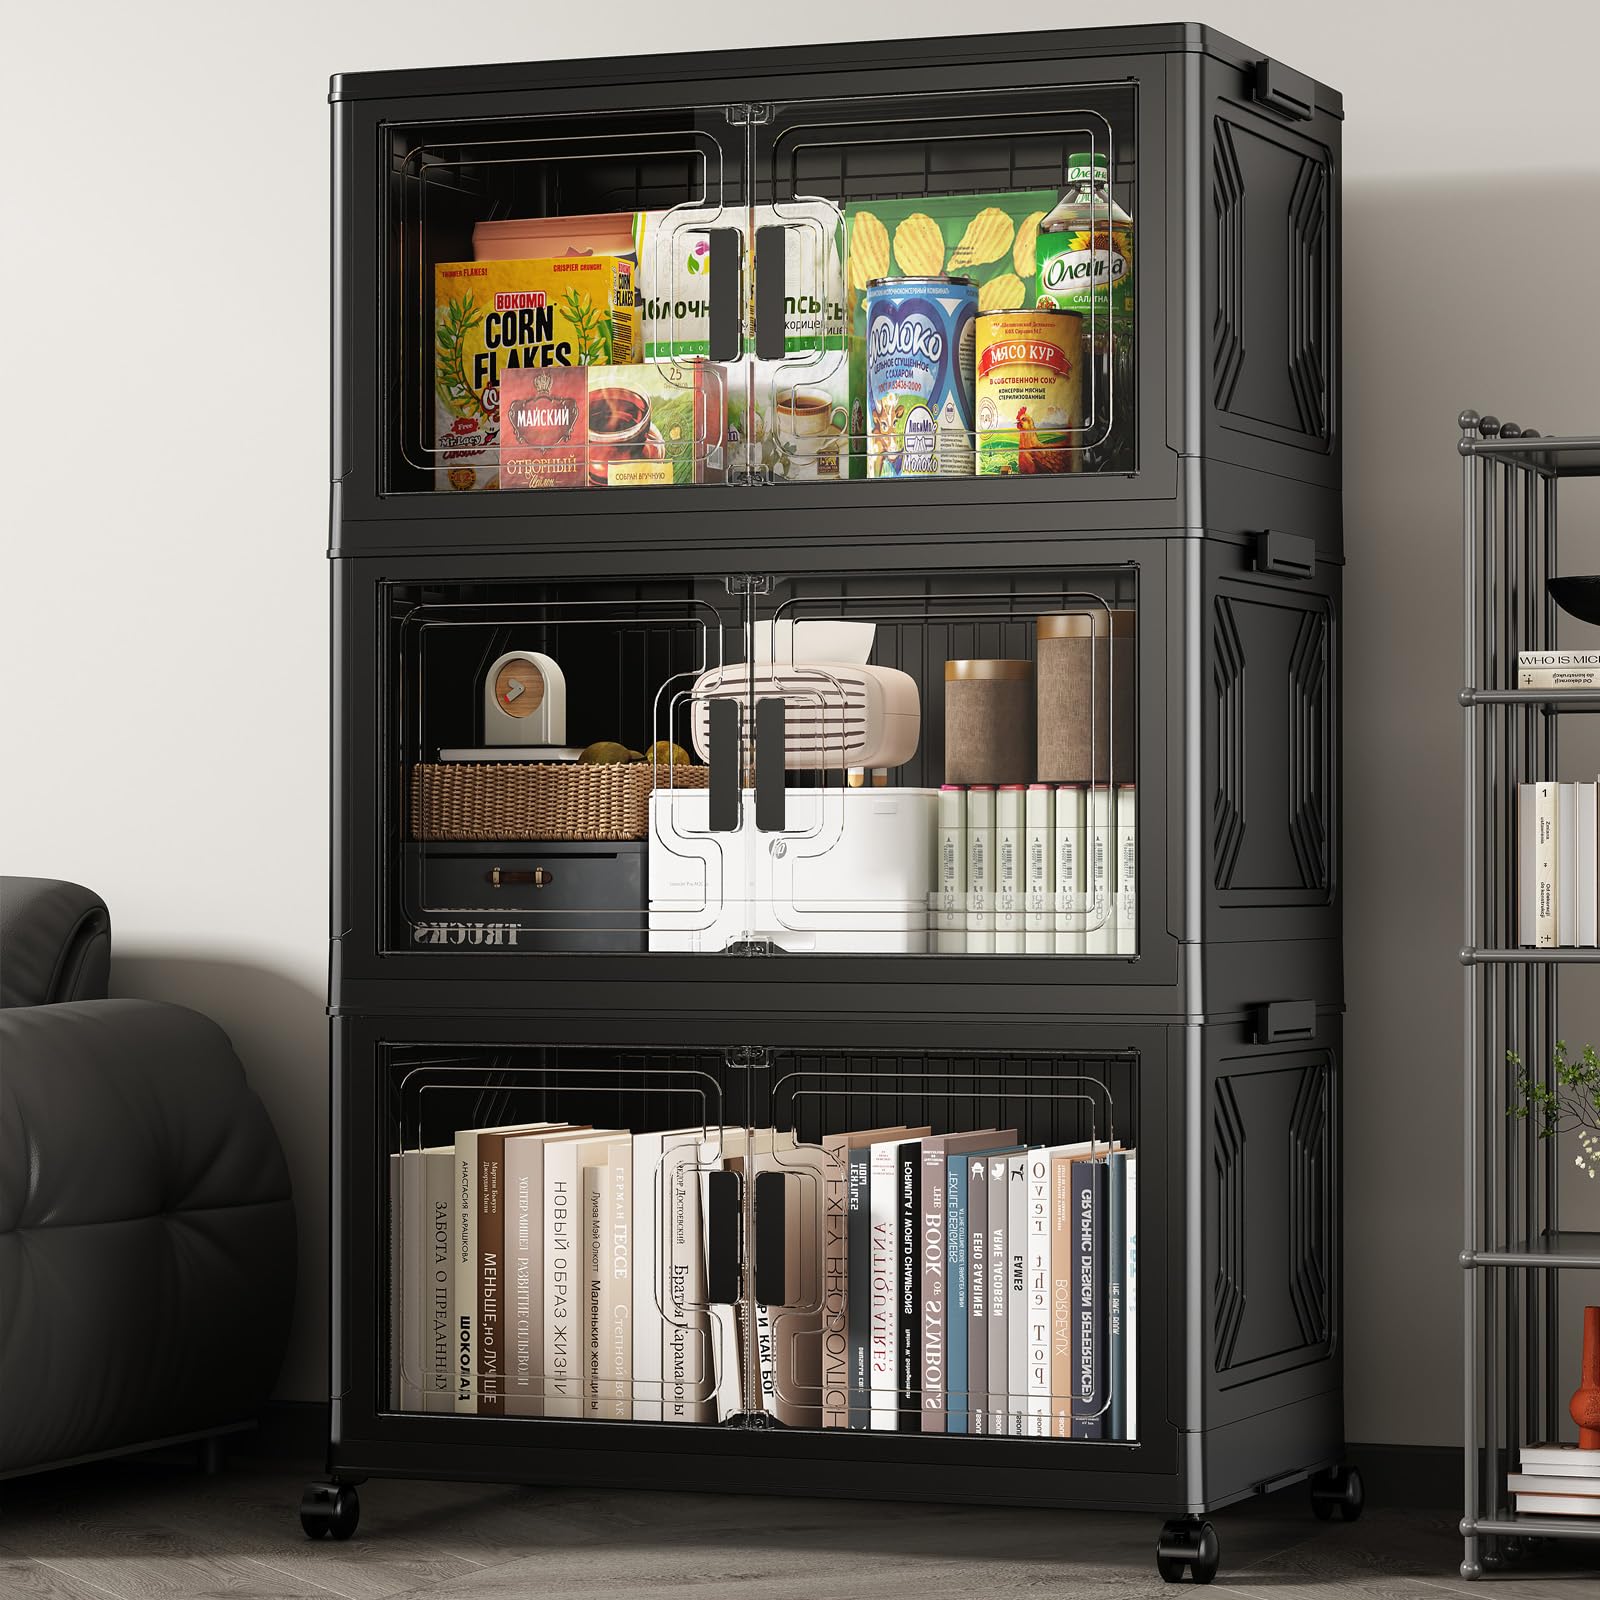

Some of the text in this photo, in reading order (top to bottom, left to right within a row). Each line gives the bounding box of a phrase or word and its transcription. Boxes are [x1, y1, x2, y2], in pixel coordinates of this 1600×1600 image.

[553, 264, 579, 272] CRISPIER
[619, 274, 631, 289] CORN
[496, 292, 545, 310] BOKOMO
[617, 291, 633, 306] FLAKES
[485, 305, 554, 349] CORN
[894, 357, 929, 372] СГУЩЕННОЕ
[990, 344, 1055, 364] МЯСО КУР
[670, 367, 682, 380] 25
[888, 370, 914, 378] САХАРОМ
[994, 377, 1039, 385] СОБСТВЕННОМ
[457, 422, 473, 431] Free
[517, 406, 569, 428] МАЙСКИЙ
[506, 454, 577, 476] ОТБОРНЫЙ
[615, 471, 666, 481] СОБРАН ВРУЧНУЮ
[1519, 655, 1600, 664] WHO IS MIC
[1542, 788, 1547, 798] 1
[518, 1176, 530, 1250] УОЛТЕР МИШЕЛ
[614, 1167, 628, 1279] ГЕРМАН ГЕССЕ
[434, 1201, 448, 1265] ЗАБОТА
[591, 1191, 600, 1272] Луиза Мэй Олкотт
[434, 1270, 448, 1283] О
[517, 1257, 530, 1318] РАЗВИТИЕ
[553, 1181, 570, 1394] НОВЫЙ ОБРАЗ ЖИЗНИ
[673, 1264, 689, 1318] Братья
[590, 1280, 600, 1348] Маленькие
[517, 1319, 530, 1354] СИЛЫ
[459, 1315, 471, 1402] ШОКОЛАД
[760, 1334, 772, 1363] КАК
[762, 1370, 774, 1398] БОГ
